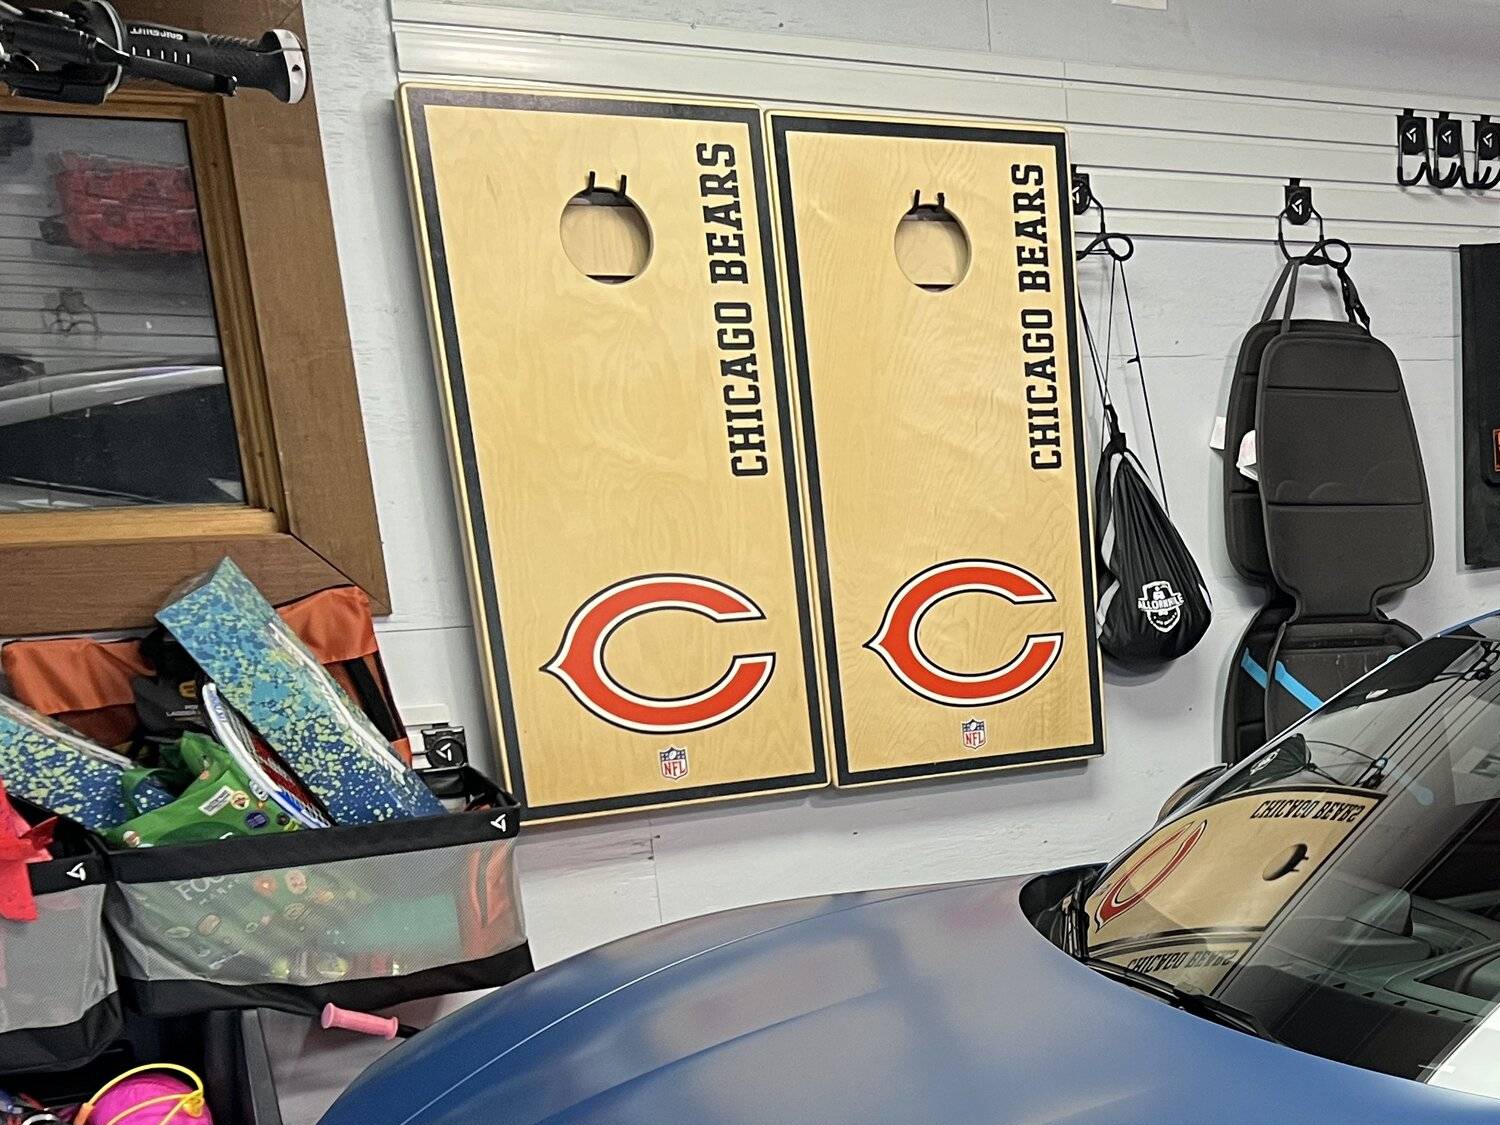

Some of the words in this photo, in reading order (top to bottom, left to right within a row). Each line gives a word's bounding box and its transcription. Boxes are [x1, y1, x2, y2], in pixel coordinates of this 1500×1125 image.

[696, 142, 749, 285] BEARS
[1010, 163, 1051, 293] BEARS
[714, 302, 769, 477] CHICAGO
[1021, 308, 1063, 470] CHICAGO
[663, 760, 687, 777] NFL
[965, 731, 985, 746] NFL
